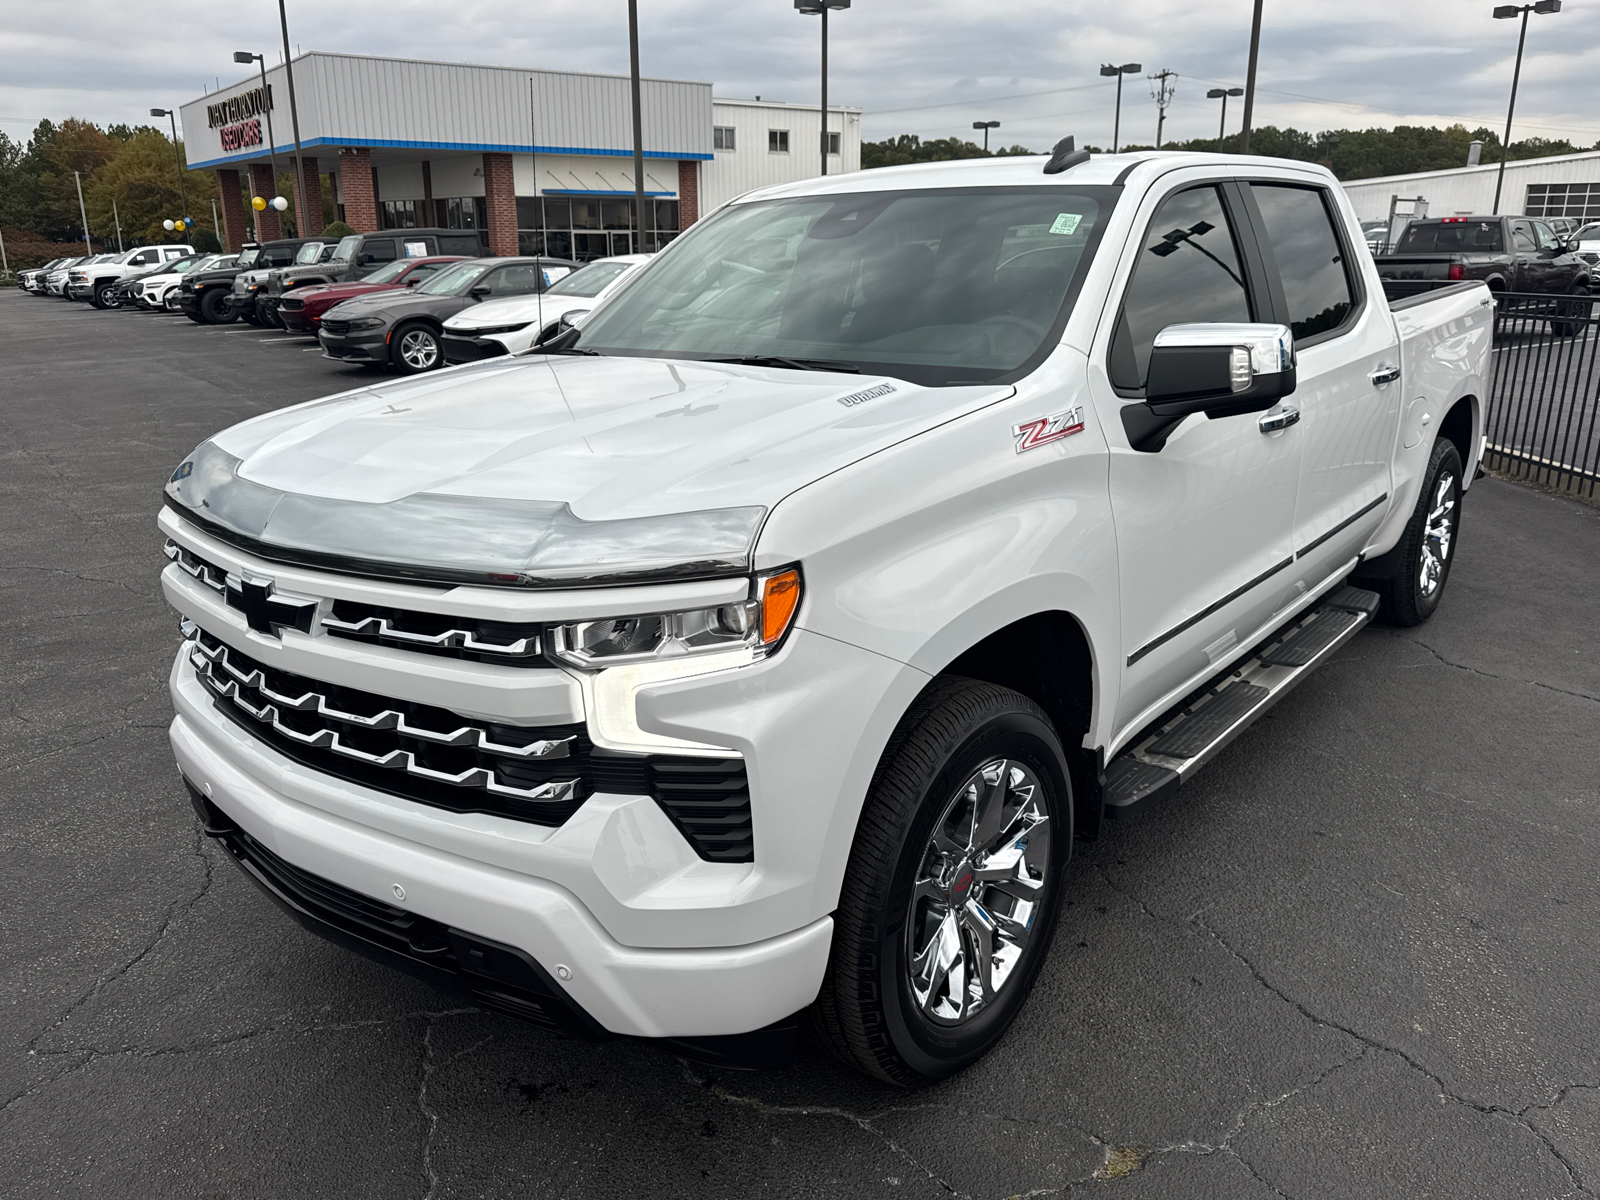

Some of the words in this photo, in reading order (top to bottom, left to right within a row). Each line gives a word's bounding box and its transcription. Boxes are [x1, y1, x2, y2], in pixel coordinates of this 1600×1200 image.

[219, 125, 240, 151] USED
[238, 119, 262, 146] CARS
[837, 382, 897, 407] DURAMAX
[1011, 406, 1085, 454] Z71
